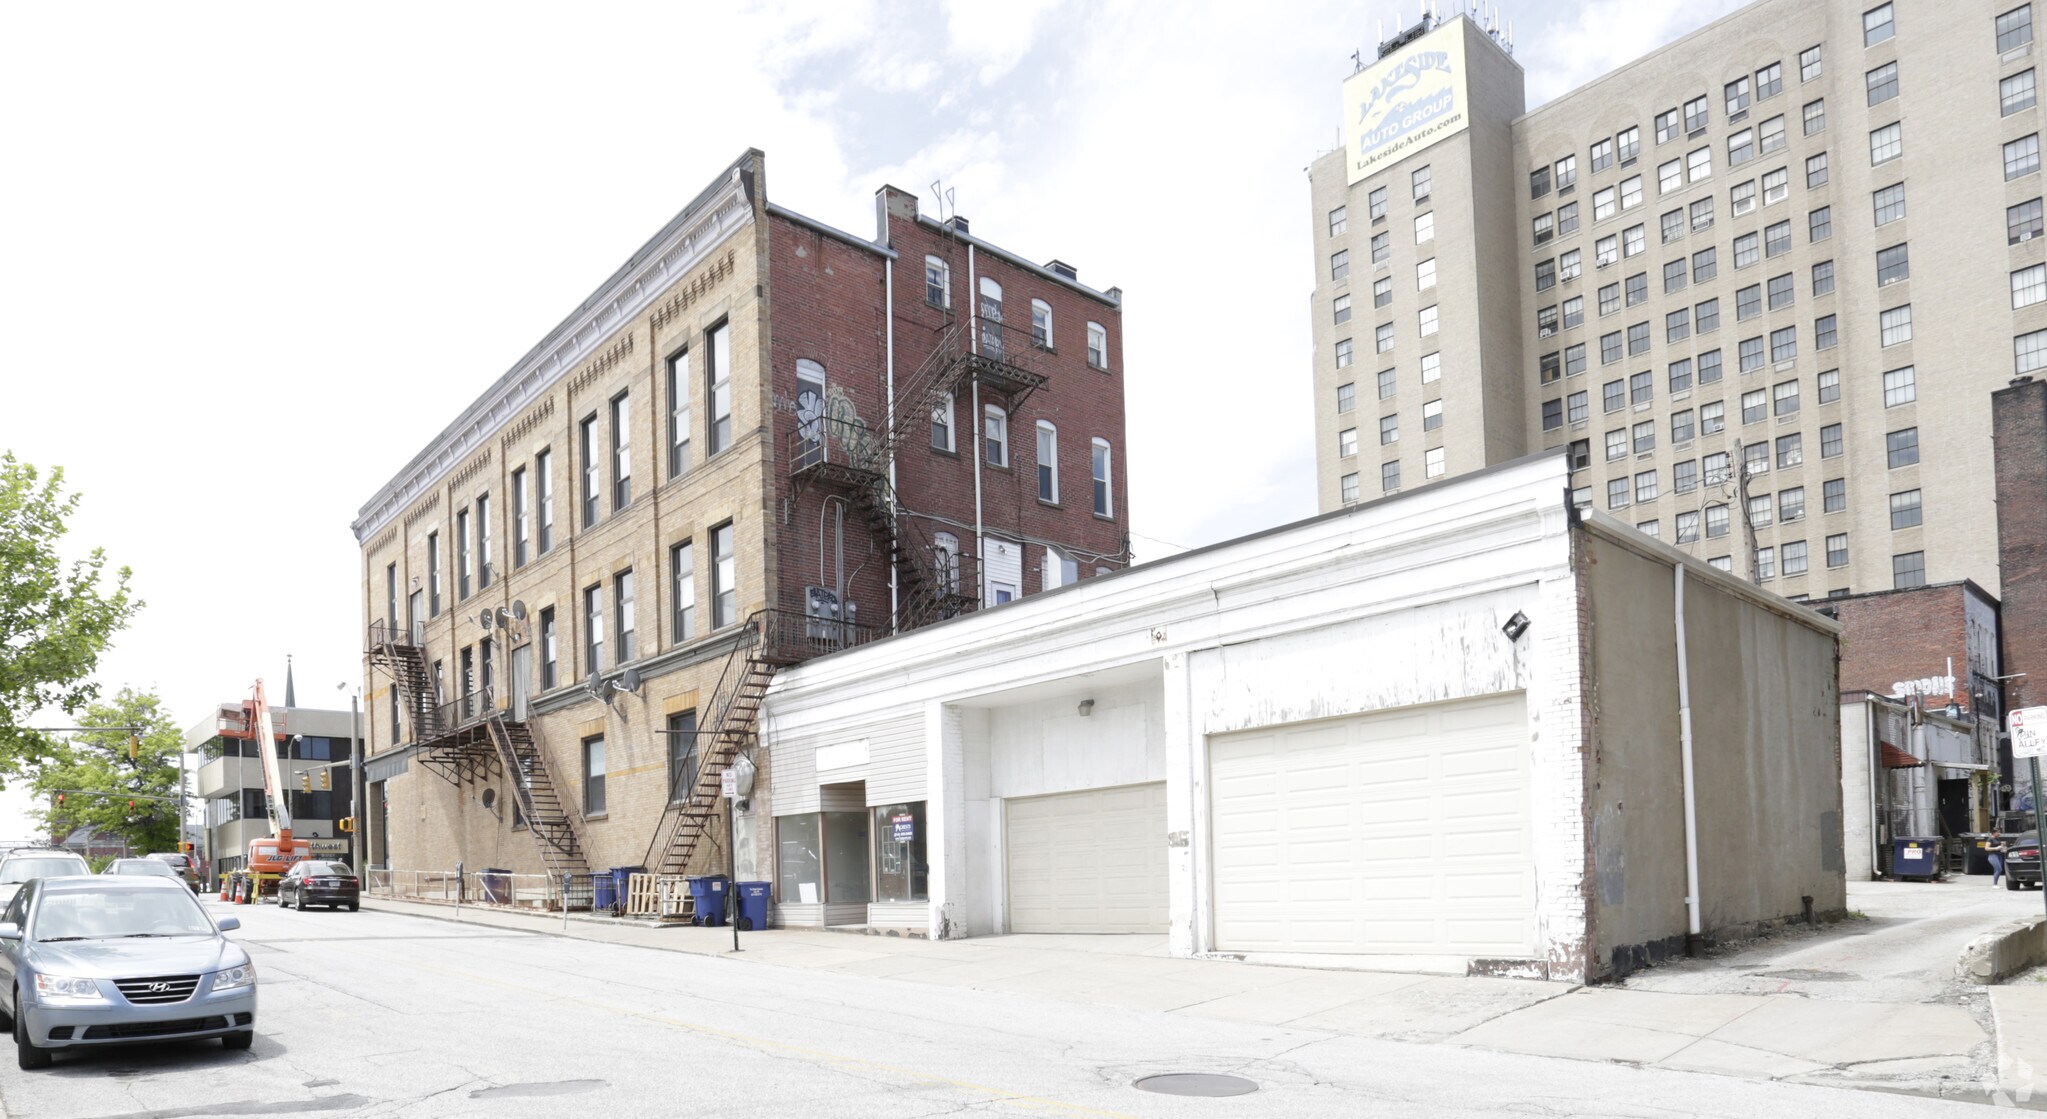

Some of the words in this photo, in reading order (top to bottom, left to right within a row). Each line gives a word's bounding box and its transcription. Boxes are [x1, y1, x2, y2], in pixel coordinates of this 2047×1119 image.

[1359, 51, 1452, 125] LAKESIDE
[1356, 112, 1462, 171] LakesideAuto.com
[1361, 123, 1399, 150] AUTO
[1401, 95, 1452, 128] GROUP
[2011, 713, 2023, 726] NO
[311, 842, 342, 850] thwest
